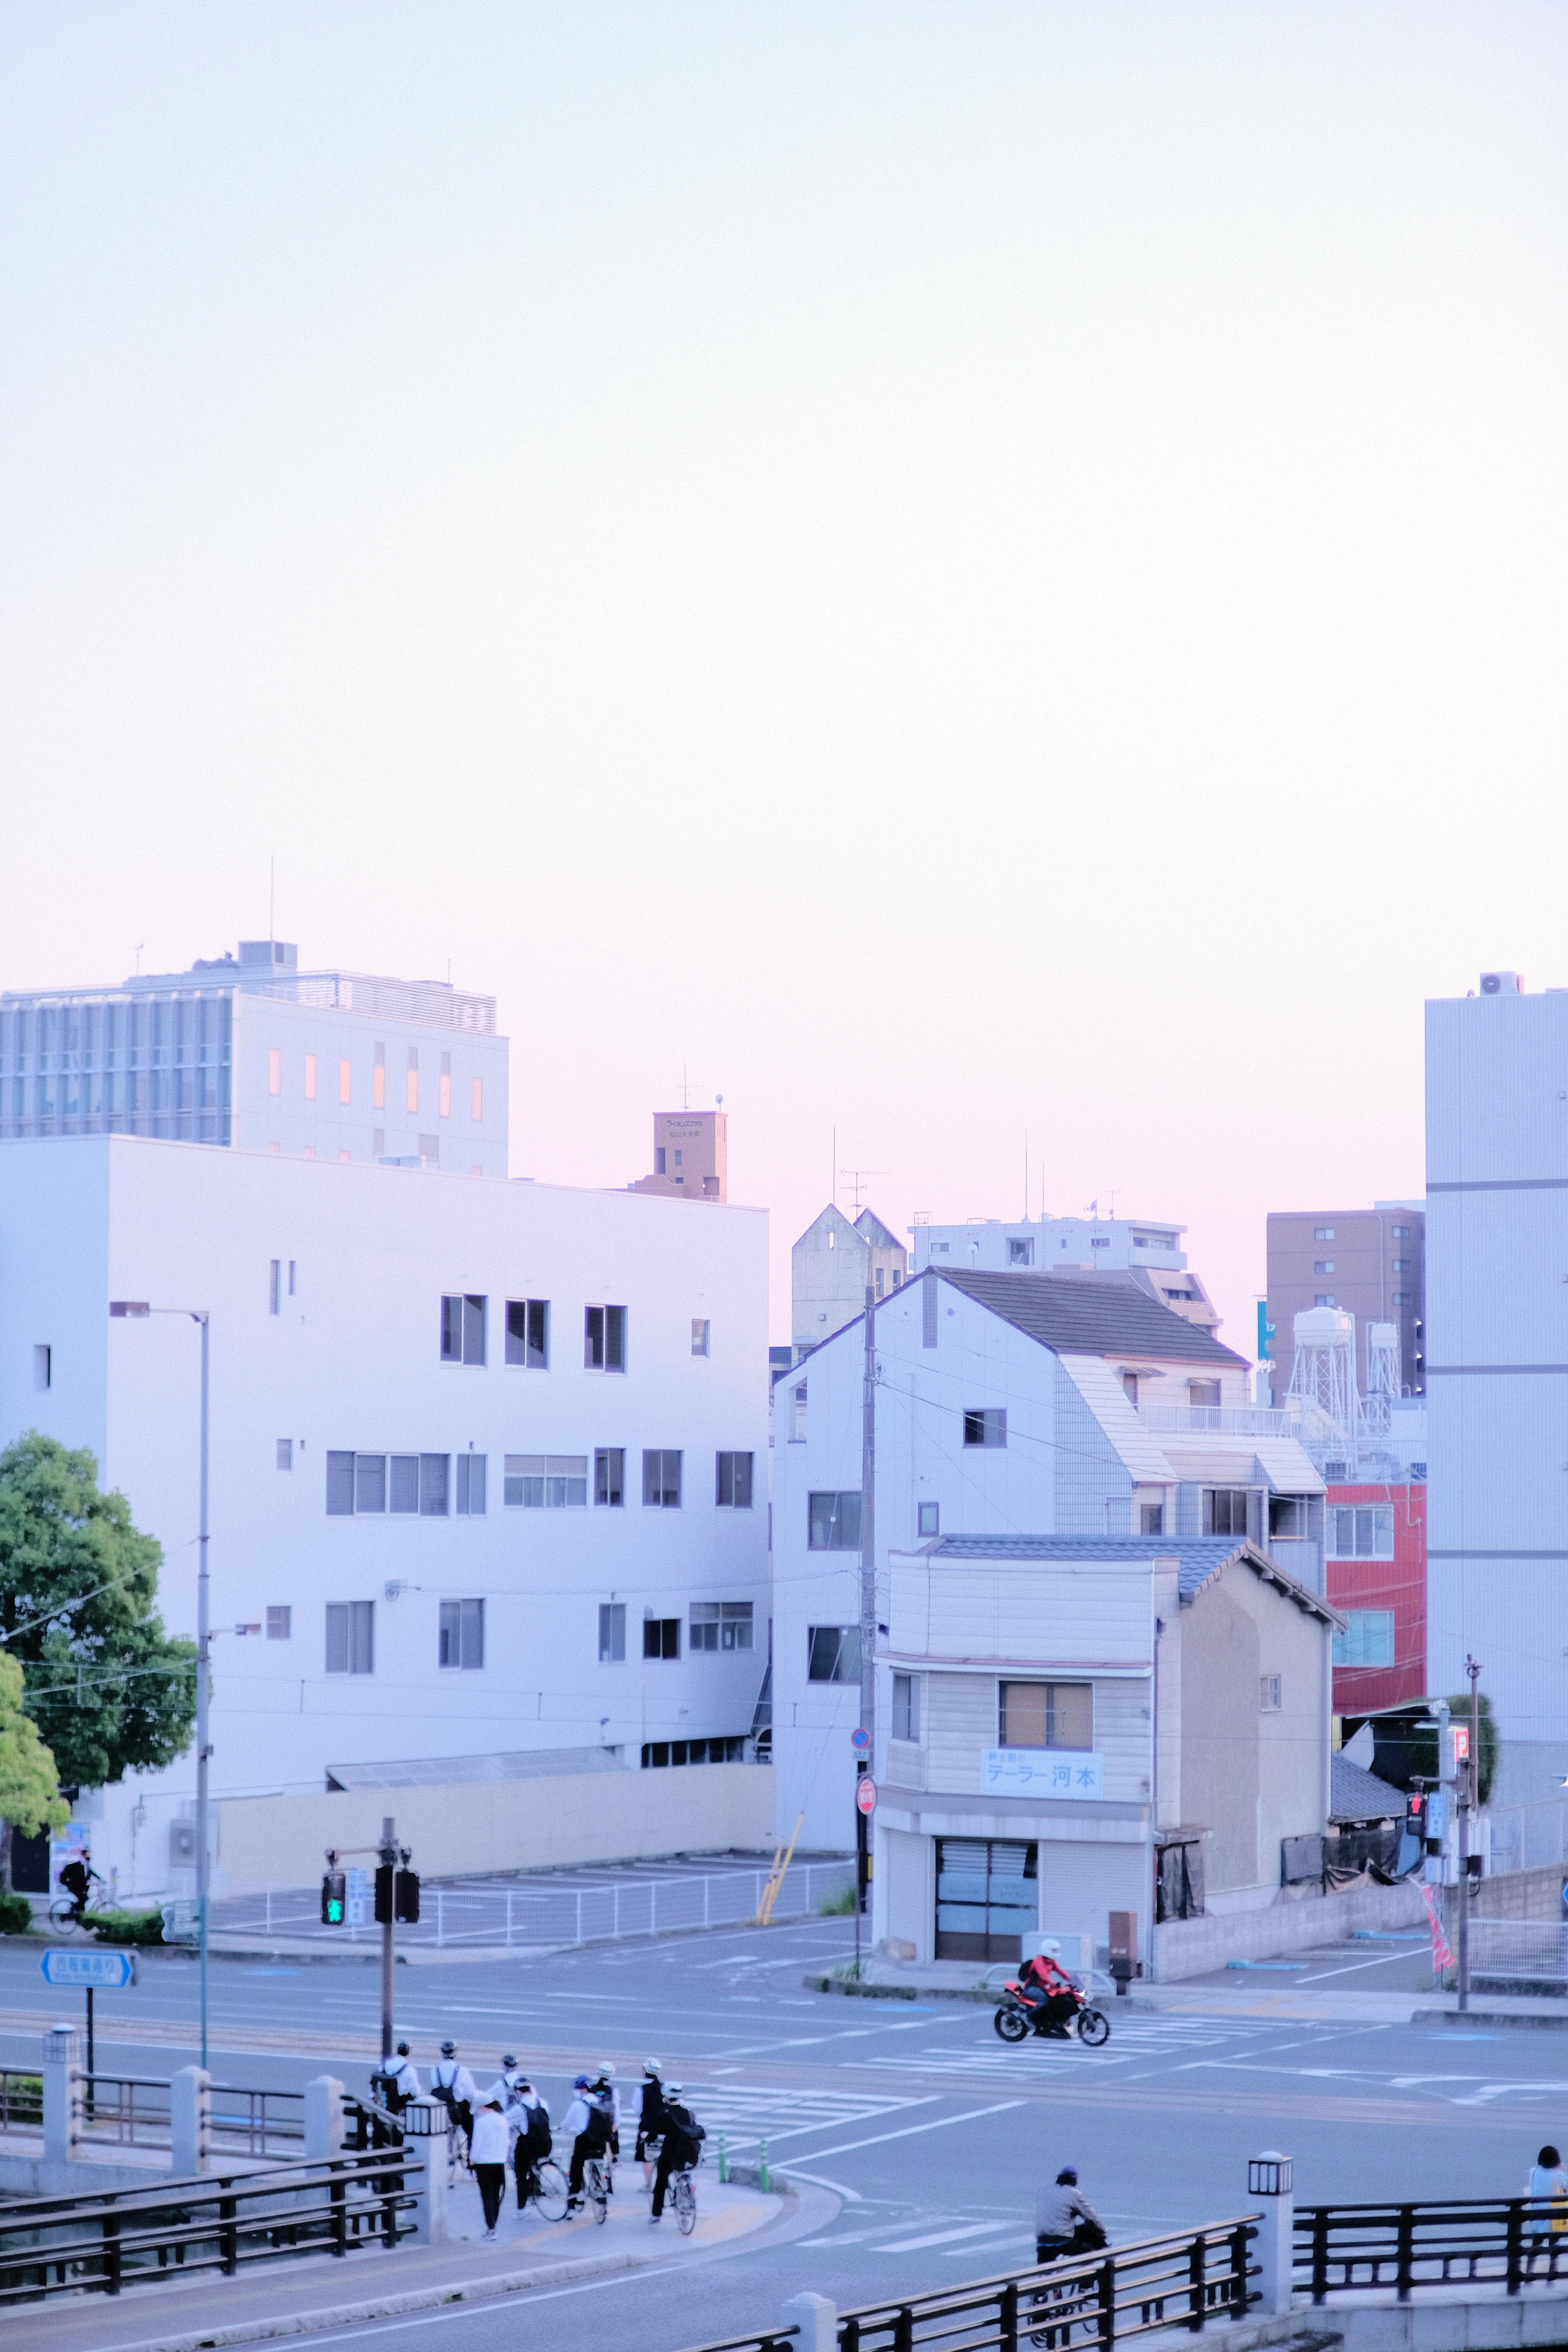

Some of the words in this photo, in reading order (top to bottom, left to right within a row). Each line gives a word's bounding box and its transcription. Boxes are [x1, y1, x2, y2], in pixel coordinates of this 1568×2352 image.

[1459, 1735, 1466, 1758] P
[989, 1765, 1095, 1788] テーラー河本
